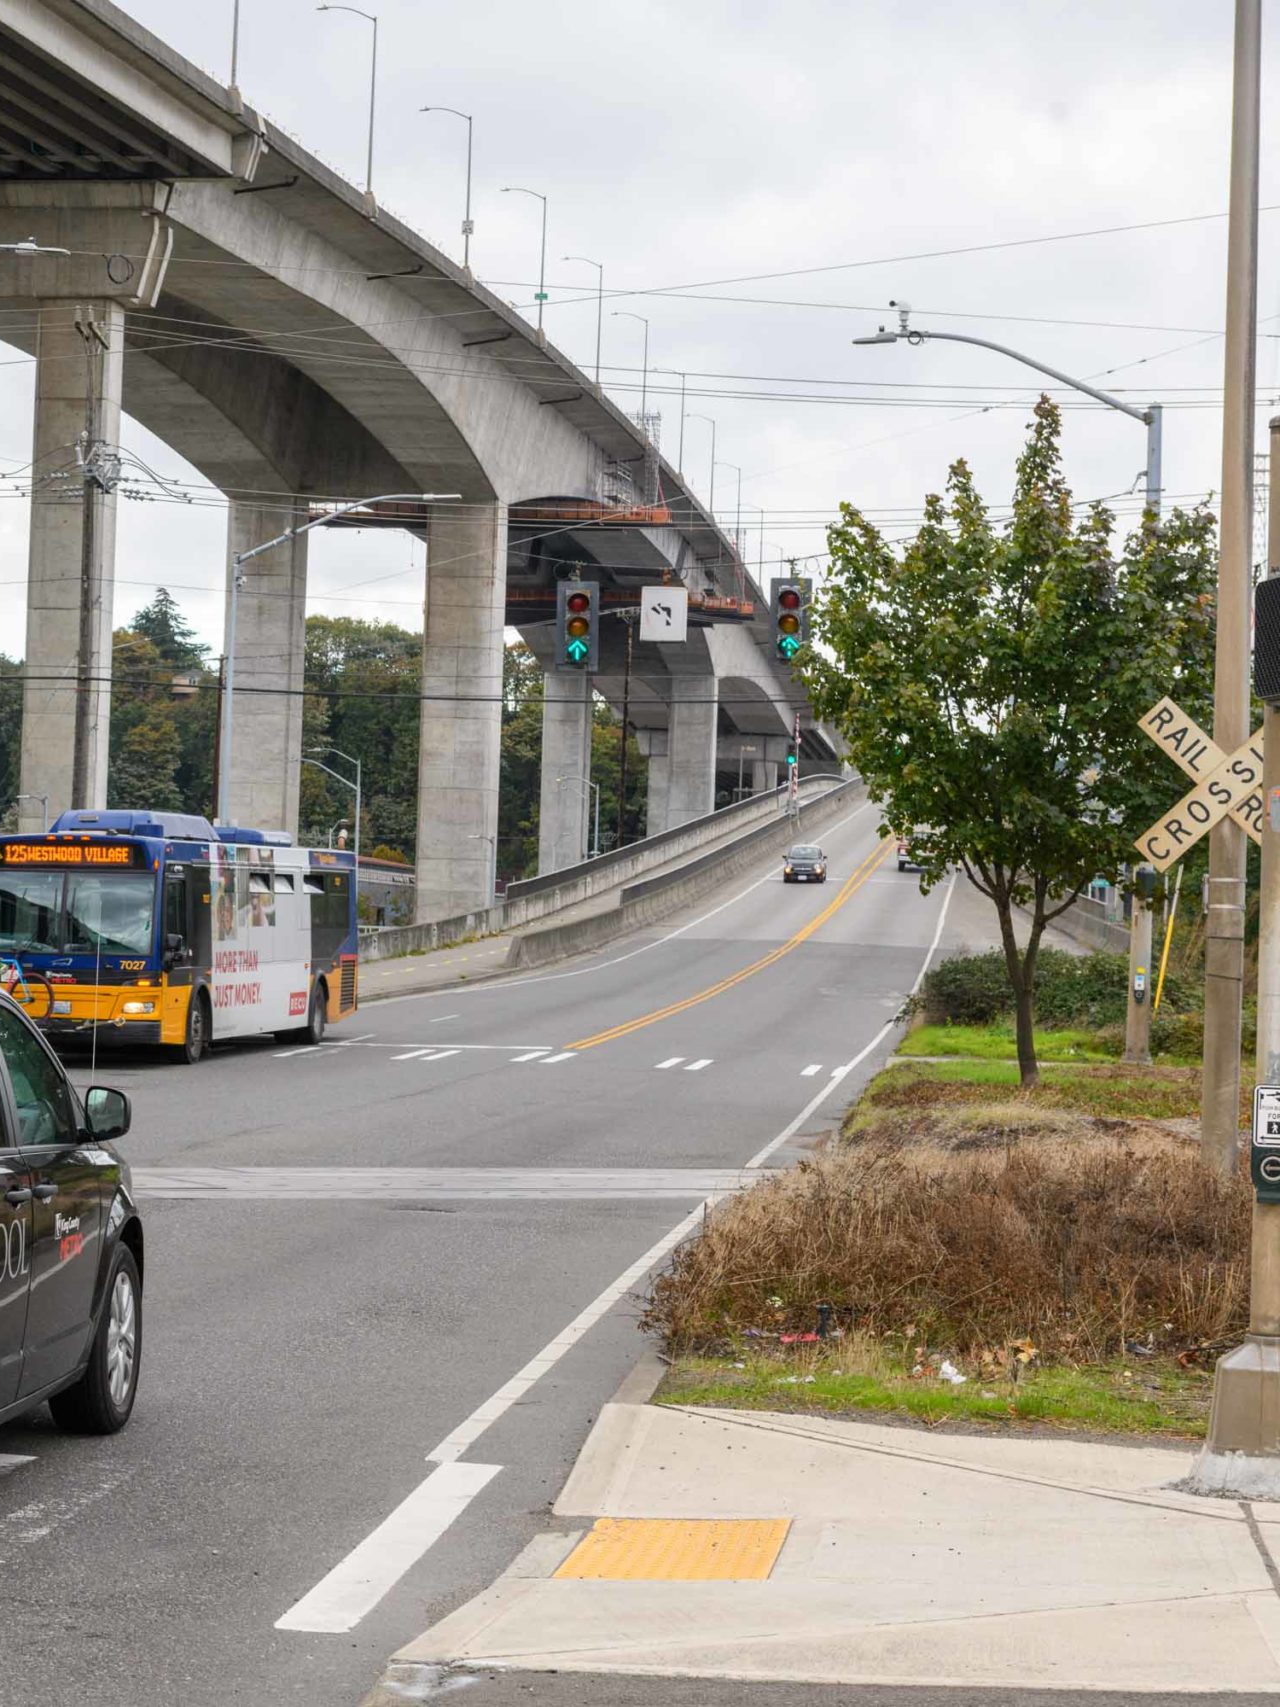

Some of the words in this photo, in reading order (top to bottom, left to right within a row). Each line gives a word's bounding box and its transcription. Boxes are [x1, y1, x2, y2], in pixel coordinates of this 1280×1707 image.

[1148, 706, 1208, 772] RAIL
[1147, 747, 1264, 860] CROSSI
[5, 844, 27, 863] 125
[27, 846, 82, 862] WESTWOOD
[85, 847, 129, 863] VILLAGE
[120, 960, 146, 971] 7027
[214, 950, 237, 974] MORE
[239, 948, 258, 972] THAN
[214, 984, 234, 1008] JUST
